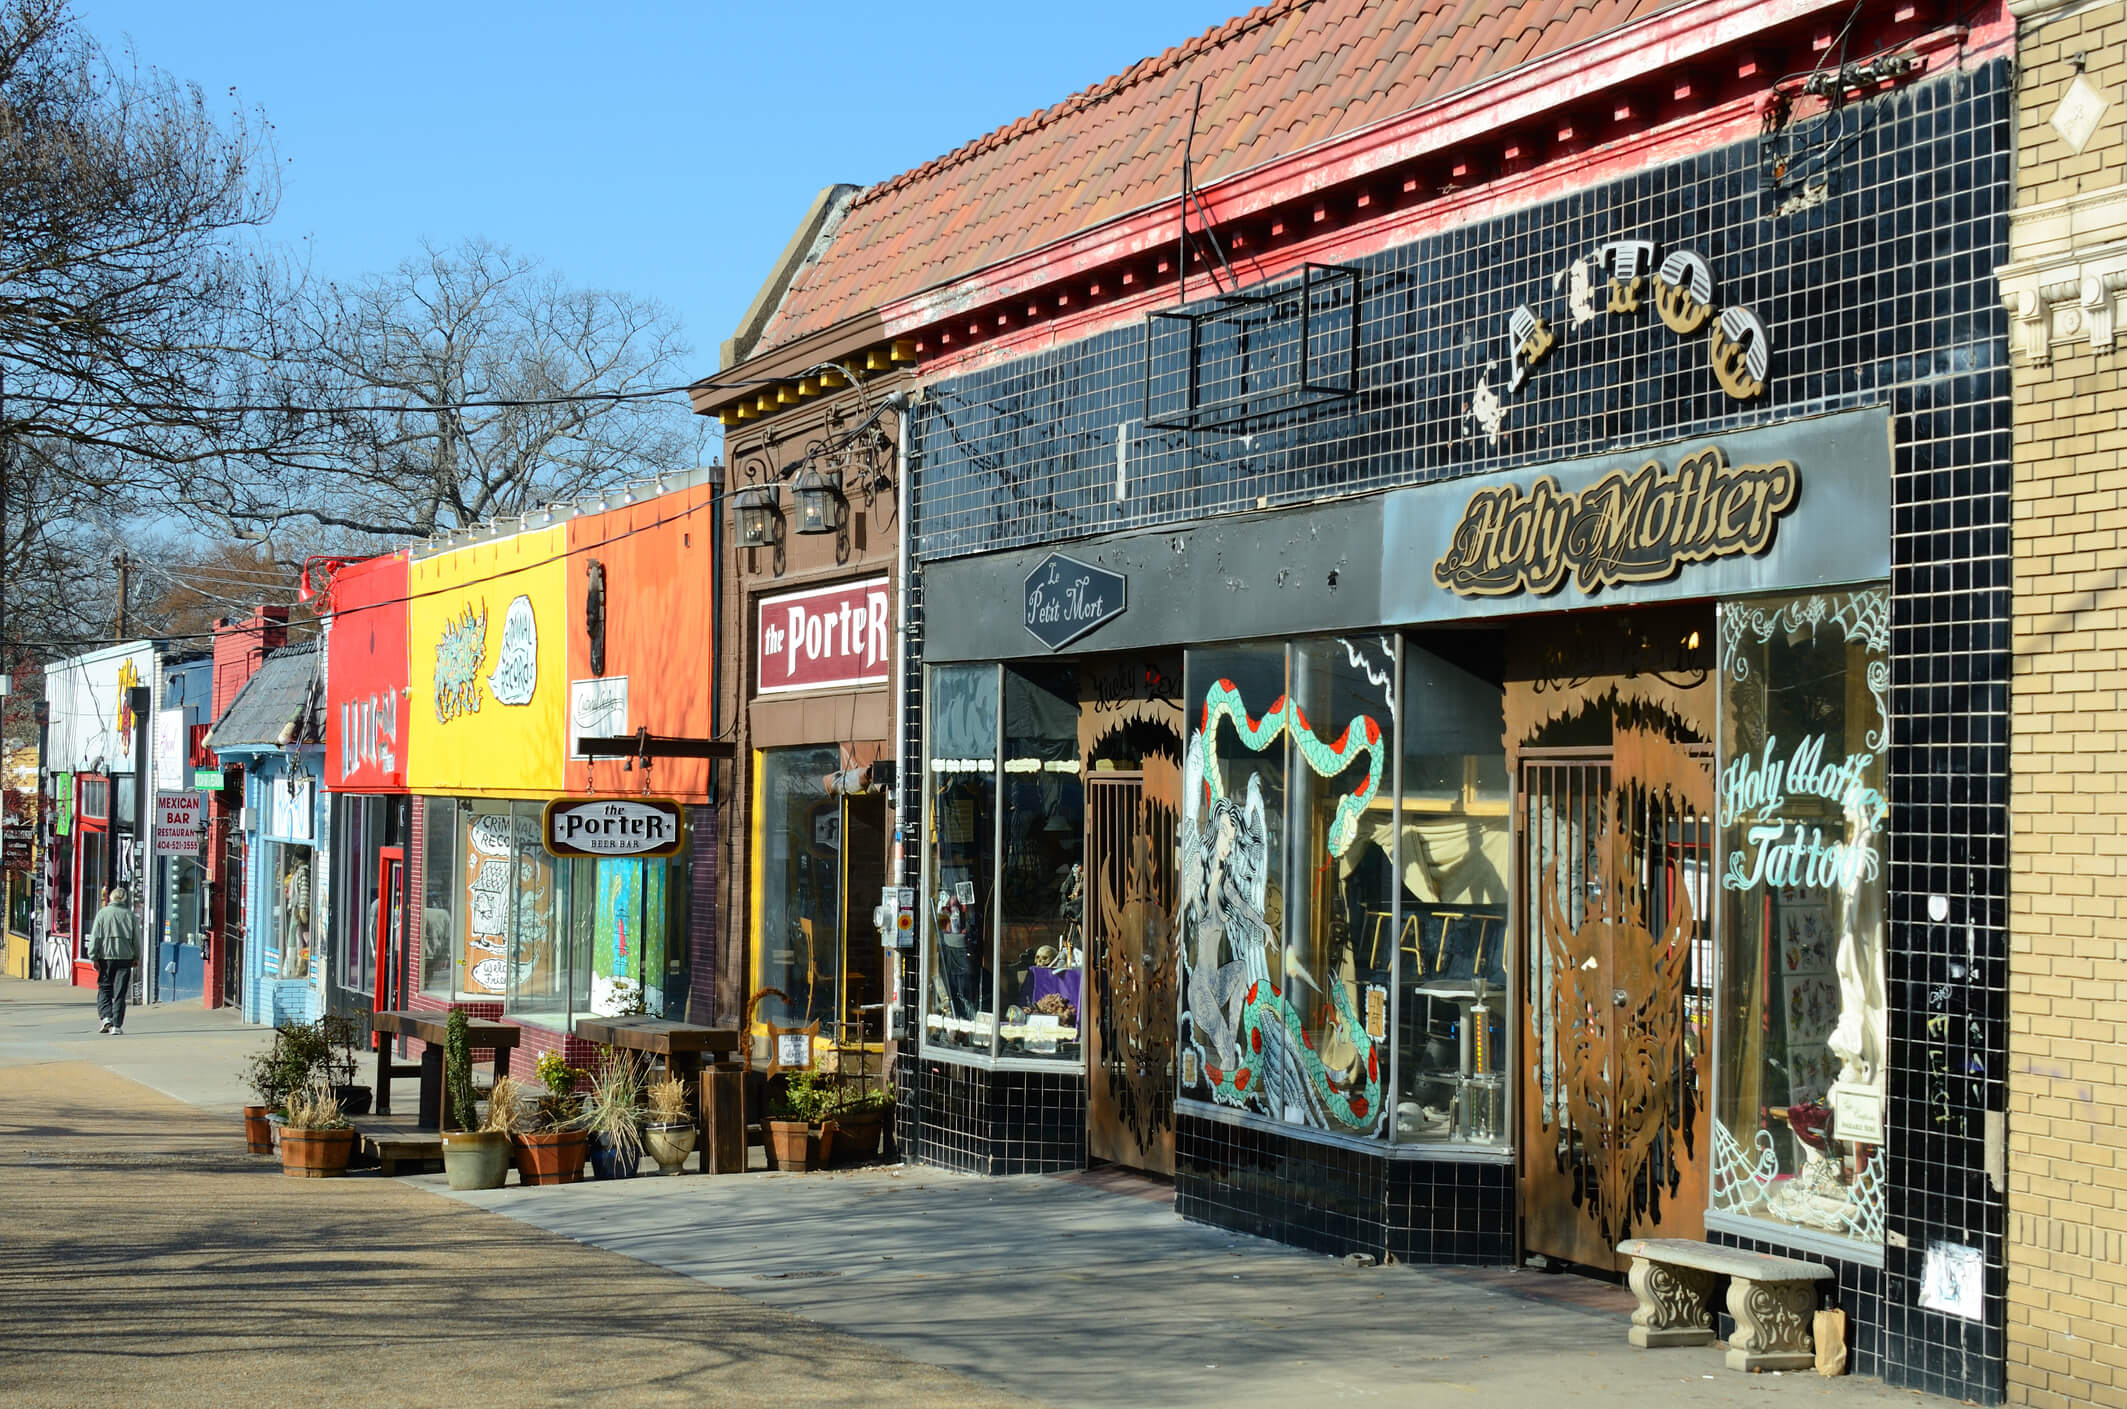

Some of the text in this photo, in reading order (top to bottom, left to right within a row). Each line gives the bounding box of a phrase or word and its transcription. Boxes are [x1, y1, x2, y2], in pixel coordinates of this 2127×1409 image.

[1440, 460, 1787, 582] Holy Mother
[1027, 575, 1104, 624] Petit Mort
[764, 623, 785, 656] the
[1720, 732, 1888, 833] Holy Mother
[158, 797, 200, 809] MEXICAN
[603, 804, 625, 816] the
[166, 812, 190, 824] BAR
[157, 827, 200, 838] RESTAURAN
[590, 839, 640, 848] BEER BAR
[1726, 817, 1861, 890] Tattoo
